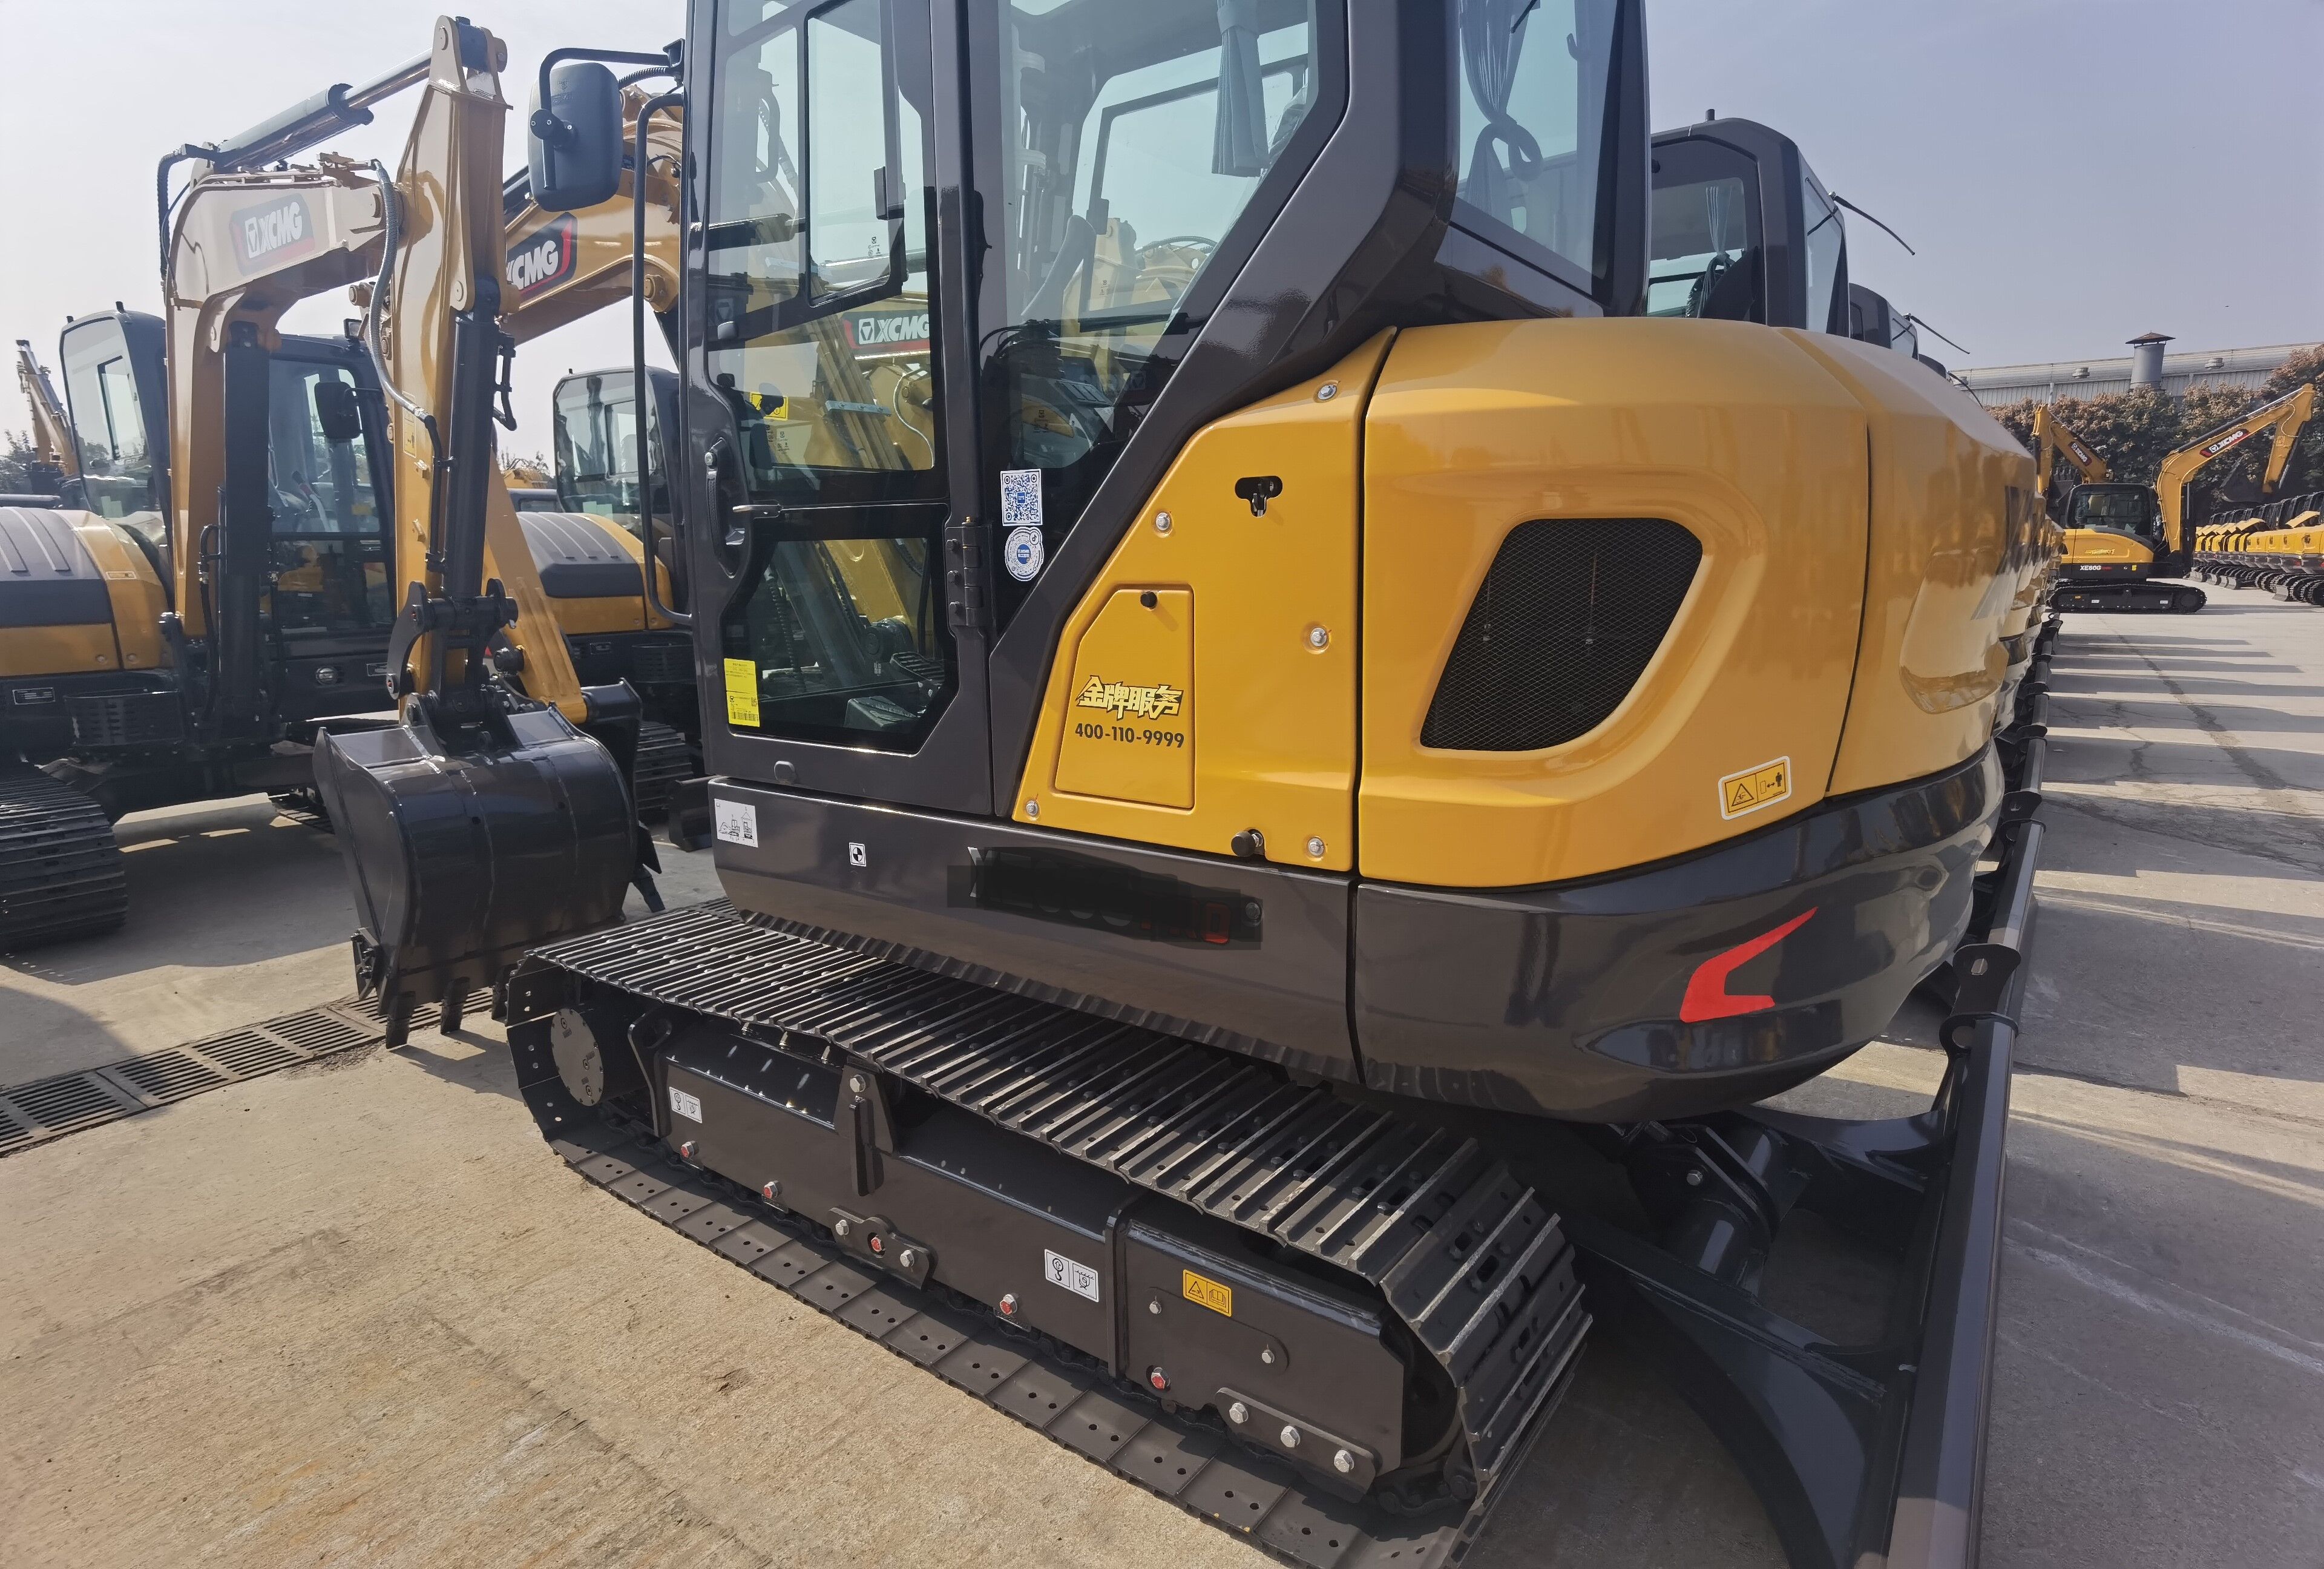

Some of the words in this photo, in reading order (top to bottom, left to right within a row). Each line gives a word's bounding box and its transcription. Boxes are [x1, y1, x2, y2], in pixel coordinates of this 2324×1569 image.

[258, 202, 302, 253] XCMG
[2217, 431, 2243, 449] XCMG
[1075, 674, 1184, 721] 金牌服务
[1075, 723, 1184, 748] 400-110-9999
